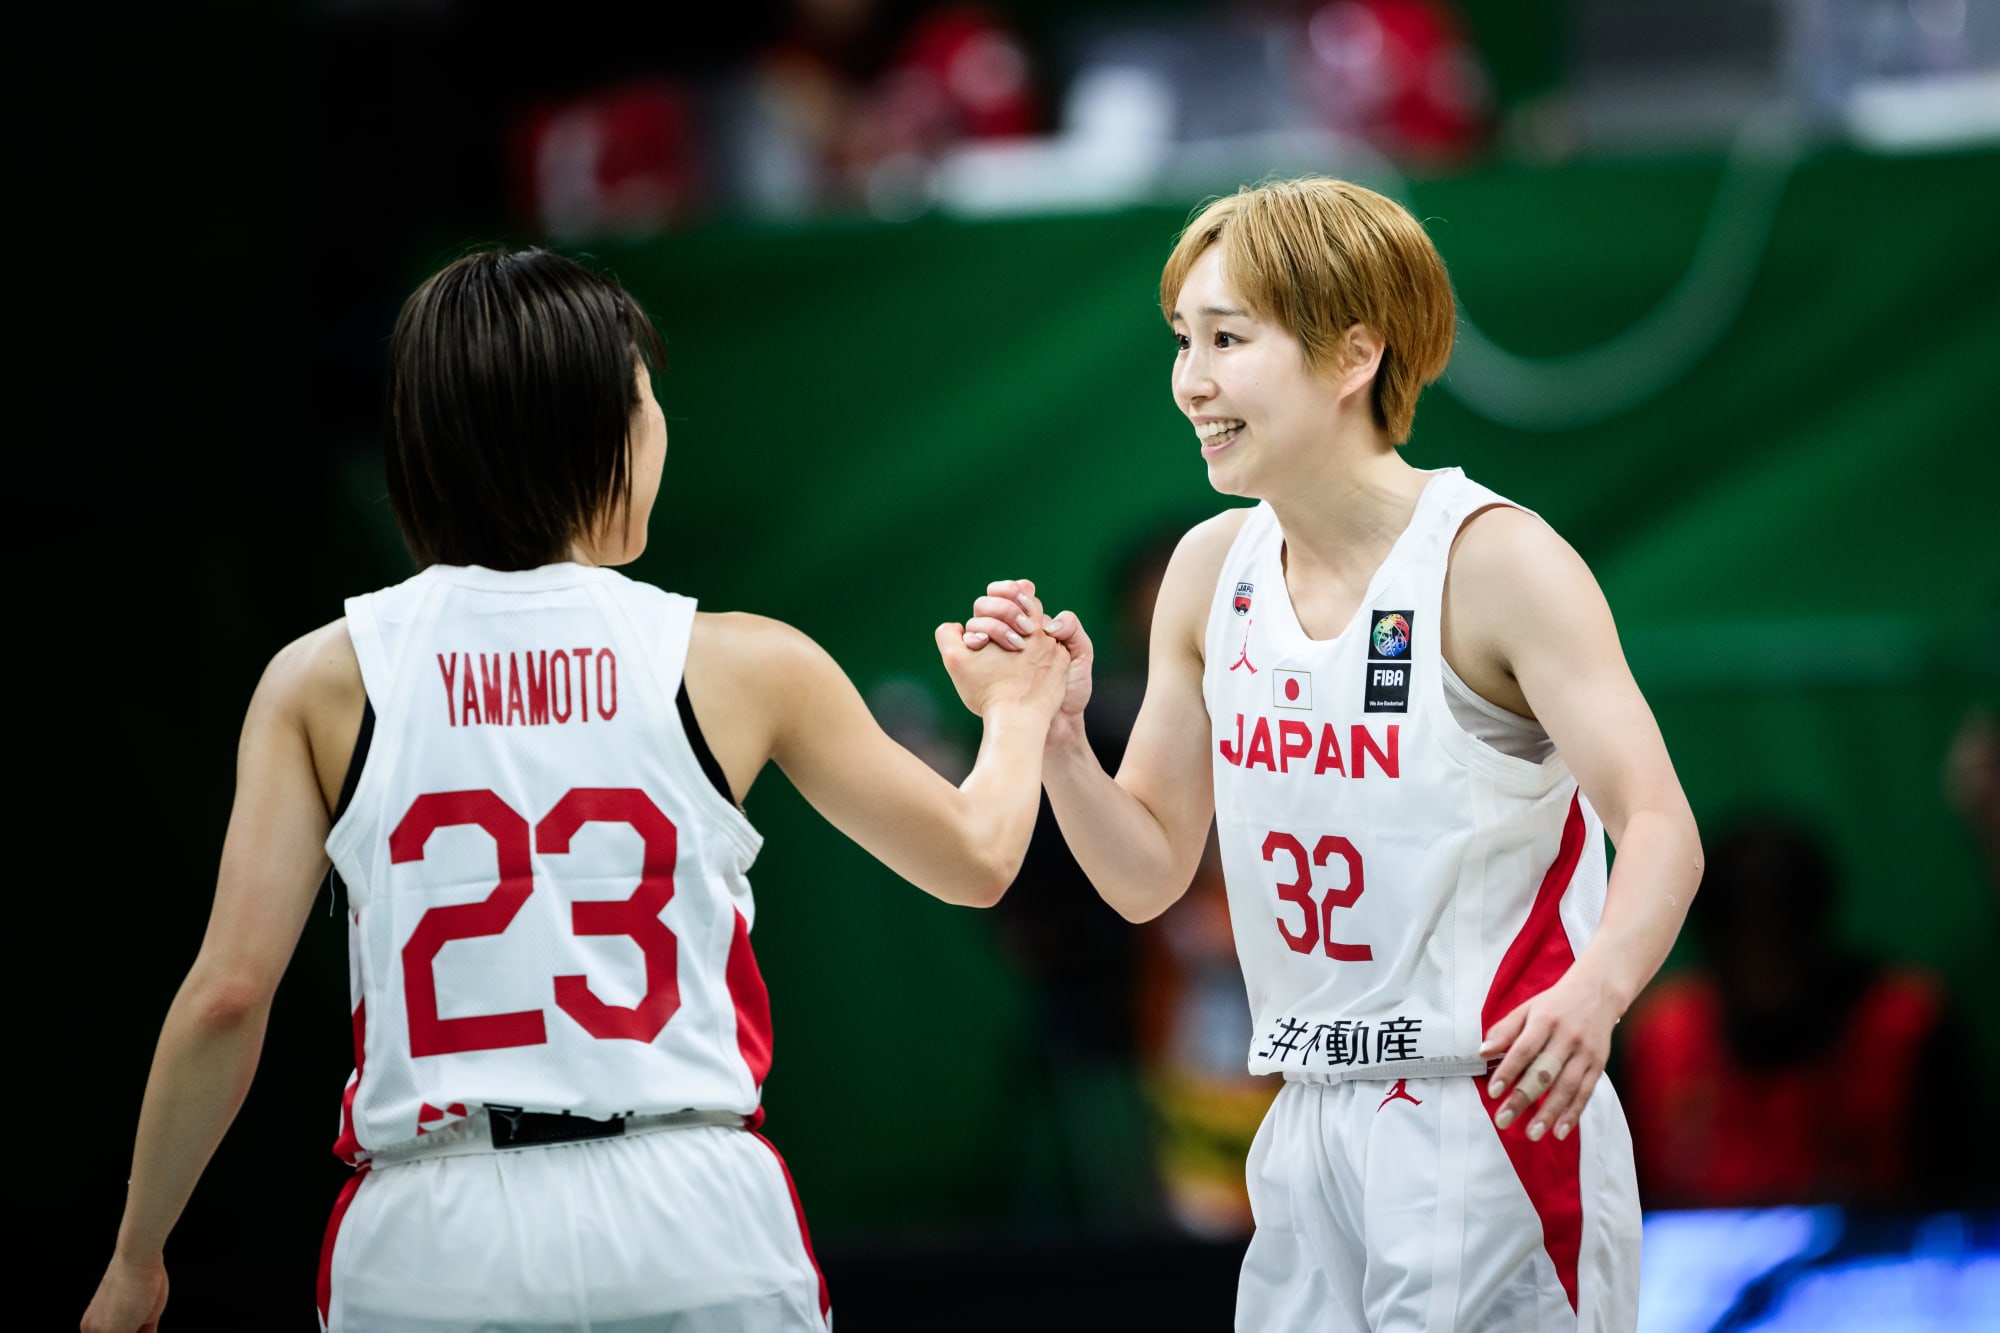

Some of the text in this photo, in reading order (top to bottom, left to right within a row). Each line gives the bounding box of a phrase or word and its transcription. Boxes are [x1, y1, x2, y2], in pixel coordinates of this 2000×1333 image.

[438, 648, 617, 726] YAMAMOTO
[1373, 669, 1404, 686] FIBA
[1219, 713, 1400, 779] JAPAN
[388, 787, 682, 1058] 23
[1261, 830, 1374, 962] 32
[1257, 1016, 1425, 1066] 井不動産
